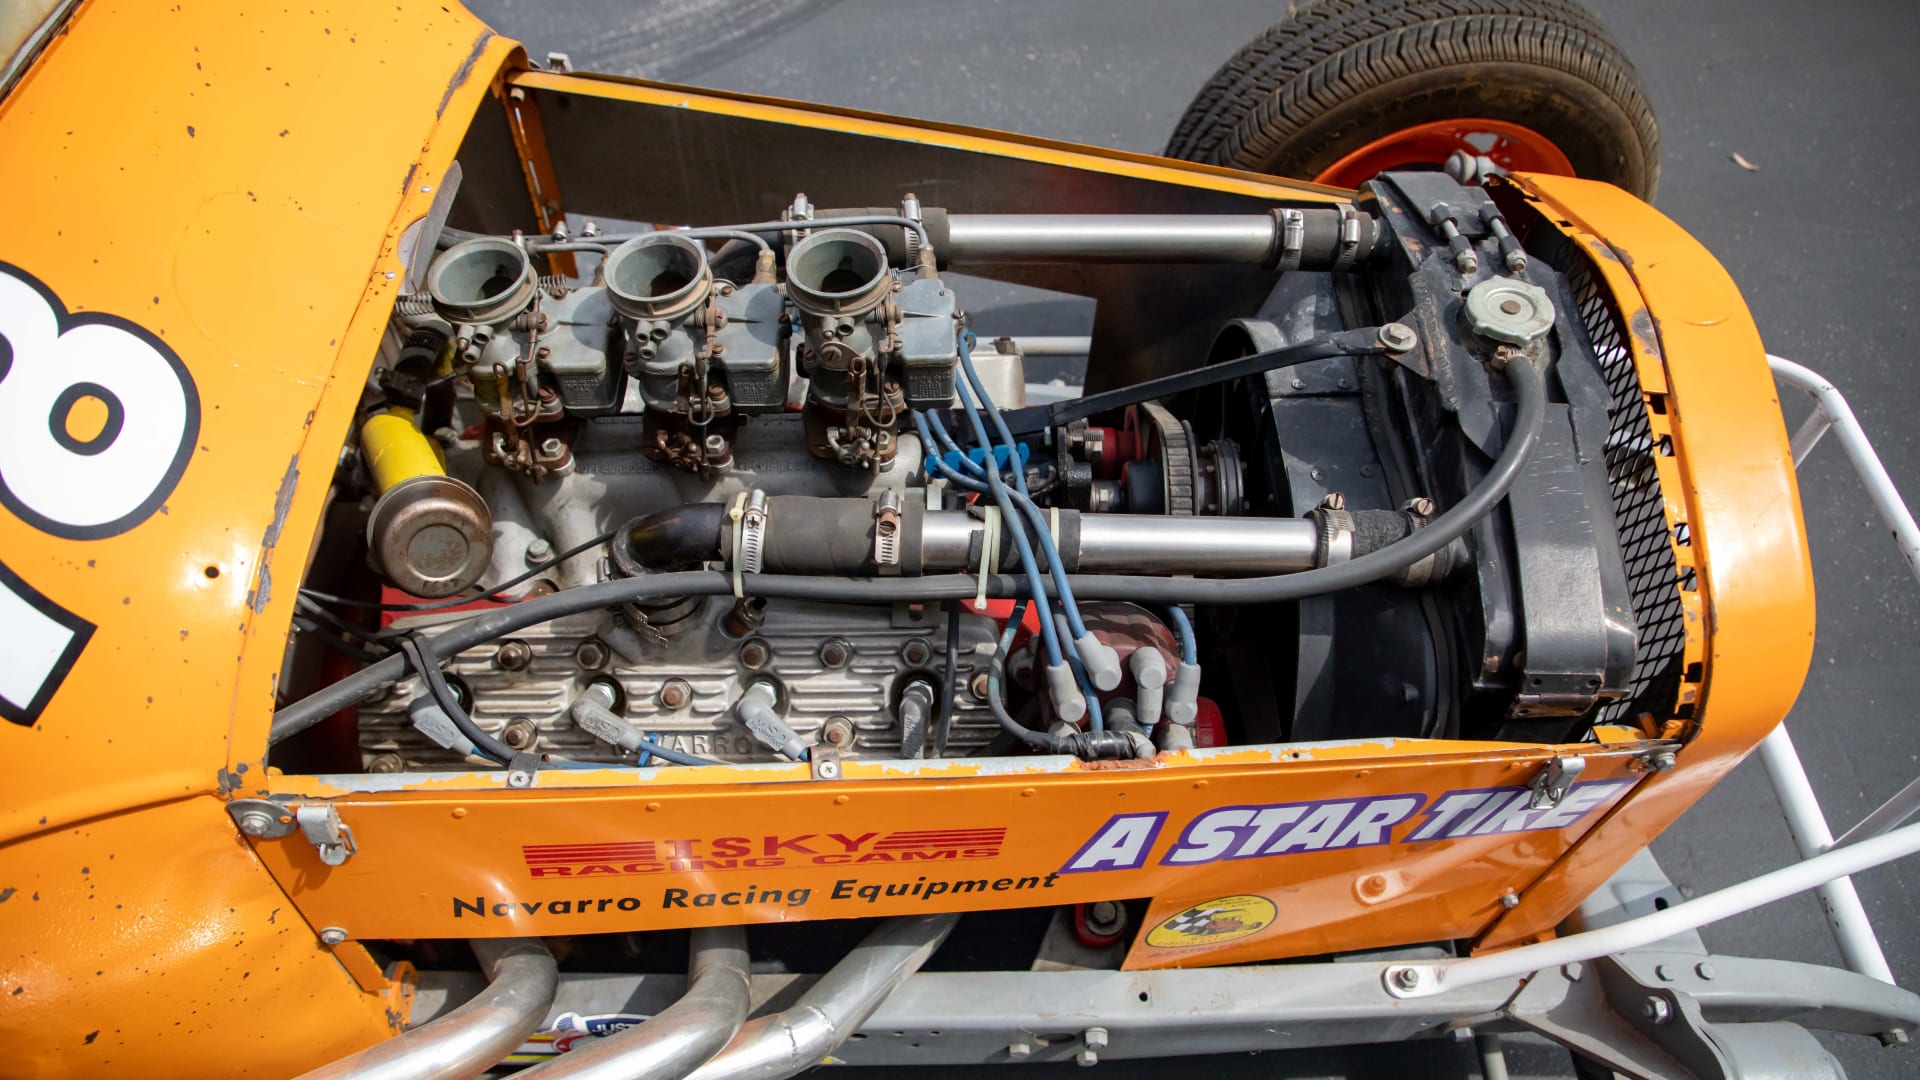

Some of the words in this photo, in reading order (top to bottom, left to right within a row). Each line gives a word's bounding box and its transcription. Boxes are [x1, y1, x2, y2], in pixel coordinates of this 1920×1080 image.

[664, 832, 881, 861] ISKY
[1068, 815, 1159, 870] A
[1169, 797, 1410, 862] STAR
[530, 857, 786, 878] RACING
[811, 848, 1001, 865] CAMS
[453, 896, 641, 918] Navarro
[662, 885, 811, 908] Racing
[830, 872, 1061, 901] Equipment
